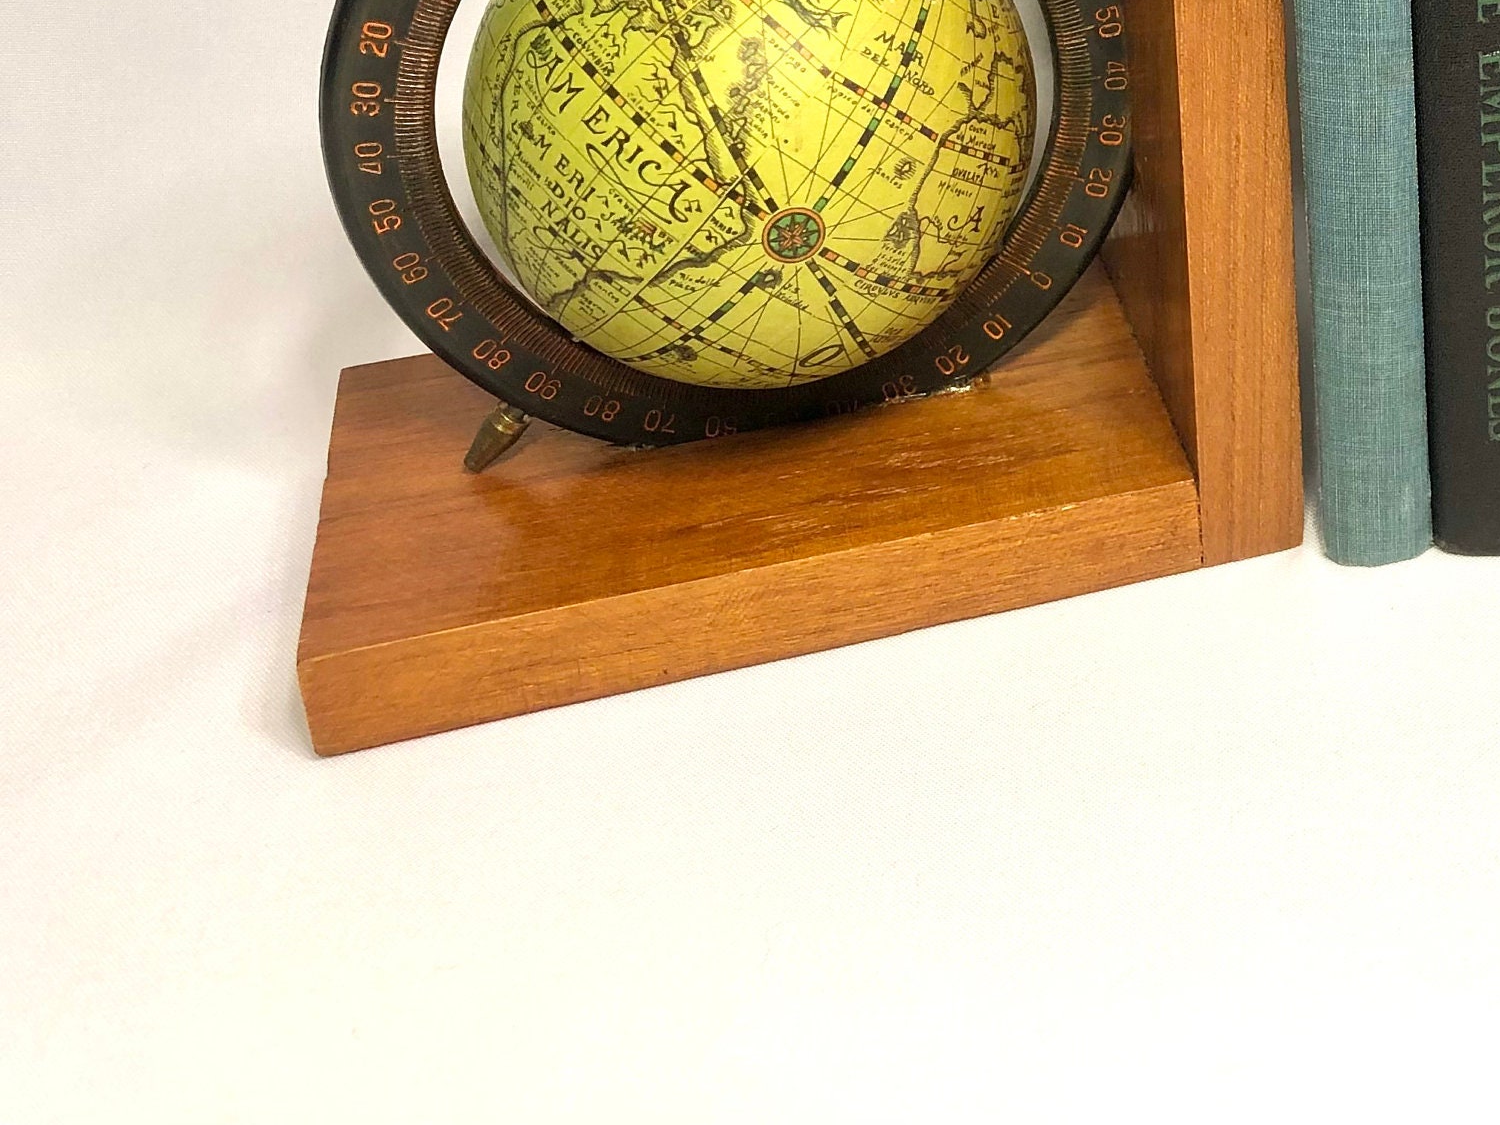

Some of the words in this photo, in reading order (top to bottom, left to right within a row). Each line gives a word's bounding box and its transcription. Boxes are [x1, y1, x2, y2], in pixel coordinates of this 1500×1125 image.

[1095, 5, 1122, 39] 50
[358, 20, 394, 59] 20
[1103, 60, 1128, 91] 40
[350, 80, 382, 117] 30
[1099, 114, 1126, 147] 30
[354, 140, 384, 175] 40
[1084, 167, 1114, 199] 20
[368, 198, 402, 235] 50
[1060, 222, 1088, 249] 10
[392, 251, 429, 285] 60
[1030, 272, 1052, 291] 0
[426, 297, 464, 332] 70
[983, 314, 1012, 340] 10
[473, 338, 511, 371] 80
[934, 344, 971, 376] 20
[523, 371, 562, 401] 90
[583, 394, 621, 421] 80
